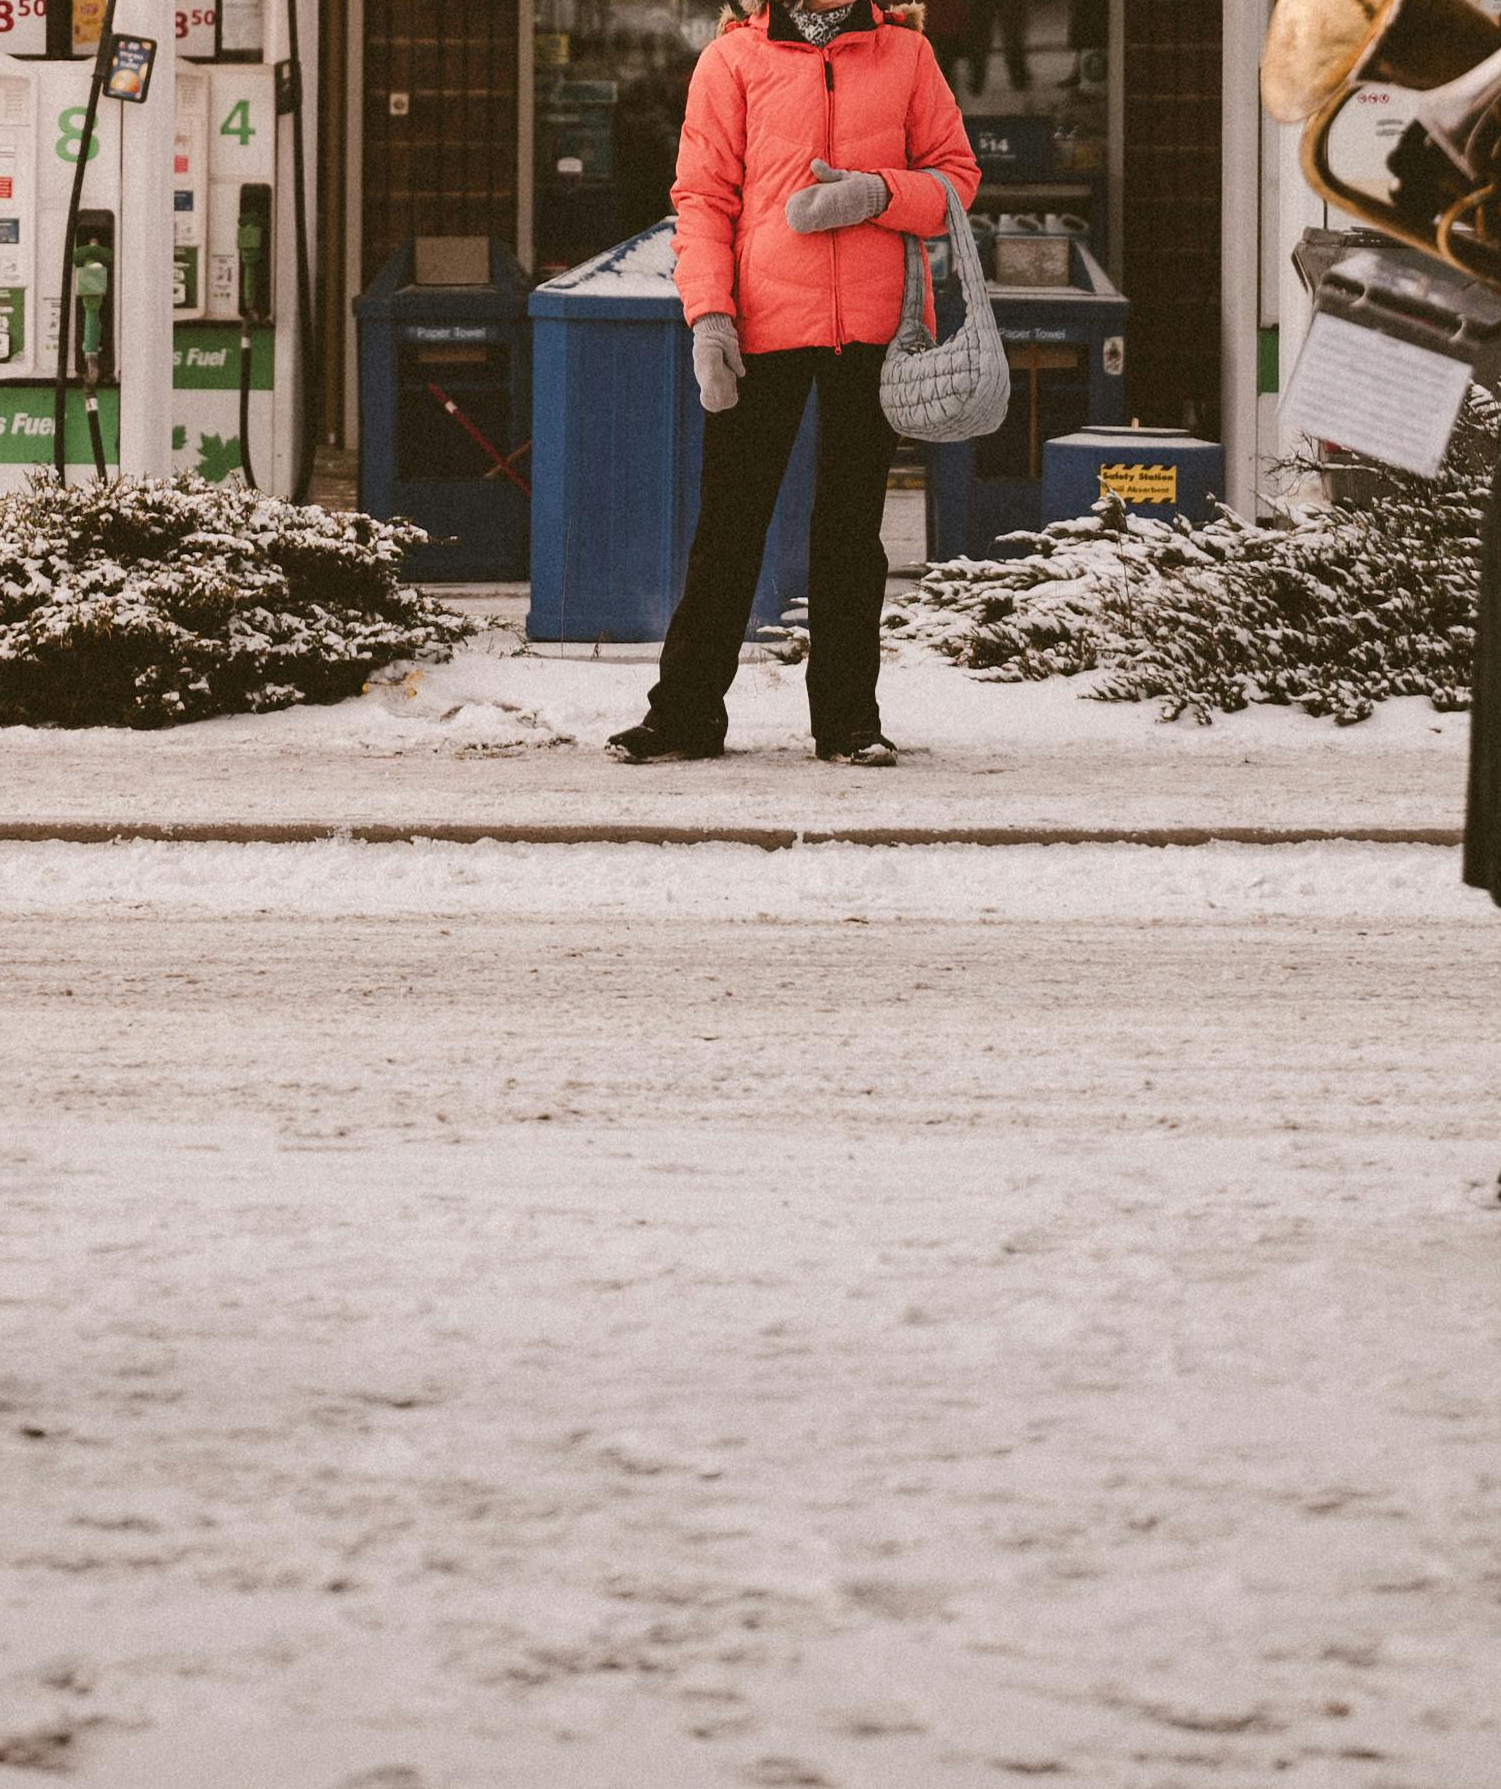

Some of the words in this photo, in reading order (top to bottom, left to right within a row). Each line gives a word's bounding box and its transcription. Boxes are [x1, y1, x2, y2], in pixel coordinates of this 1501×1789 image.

[221, 99, 255, 145] 4
[55, 106, 100, 163] 8
[417, 326, 451, 341] Paper
[454, 326, 486, 338] Towel
[999, 327, 1032, 341] Paper
[1035, 327, 1066, 339] Towel
[187, 347, 227, 367] Fuel
[1103, 472, 1135, 481] Safety
[1139, 472, 1174, 481] Station
